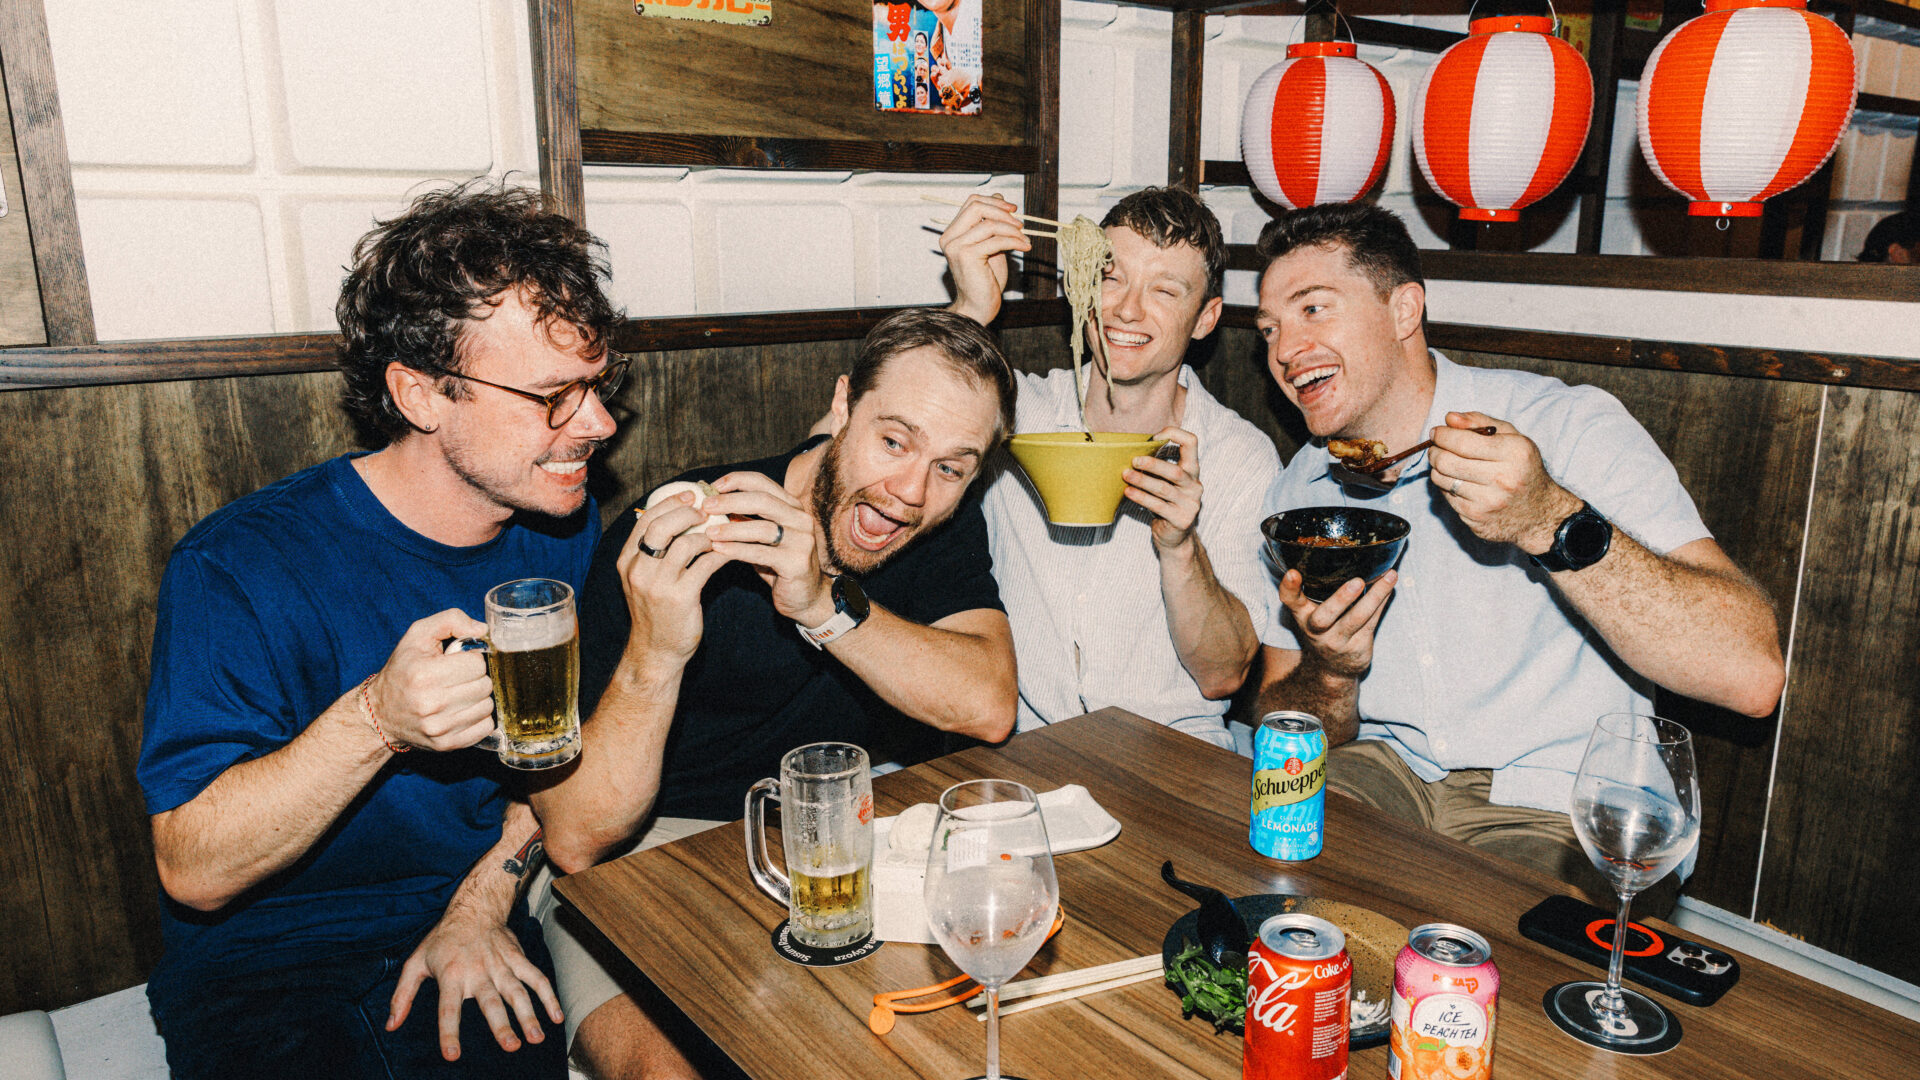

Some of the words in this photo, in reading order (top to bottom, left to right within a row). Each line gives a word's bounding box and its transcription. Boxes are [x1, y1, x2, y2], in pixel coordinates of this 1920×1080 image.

[1262, 817, 1318, 833] LEMONADE
[834, 948, 867, 962] Gyoza
[1438, 1011, 1463, 1023] ICE
[1422, 1023, 1459, 1039] PEACH
[1460, 1027, 1478, 1039] TEA
